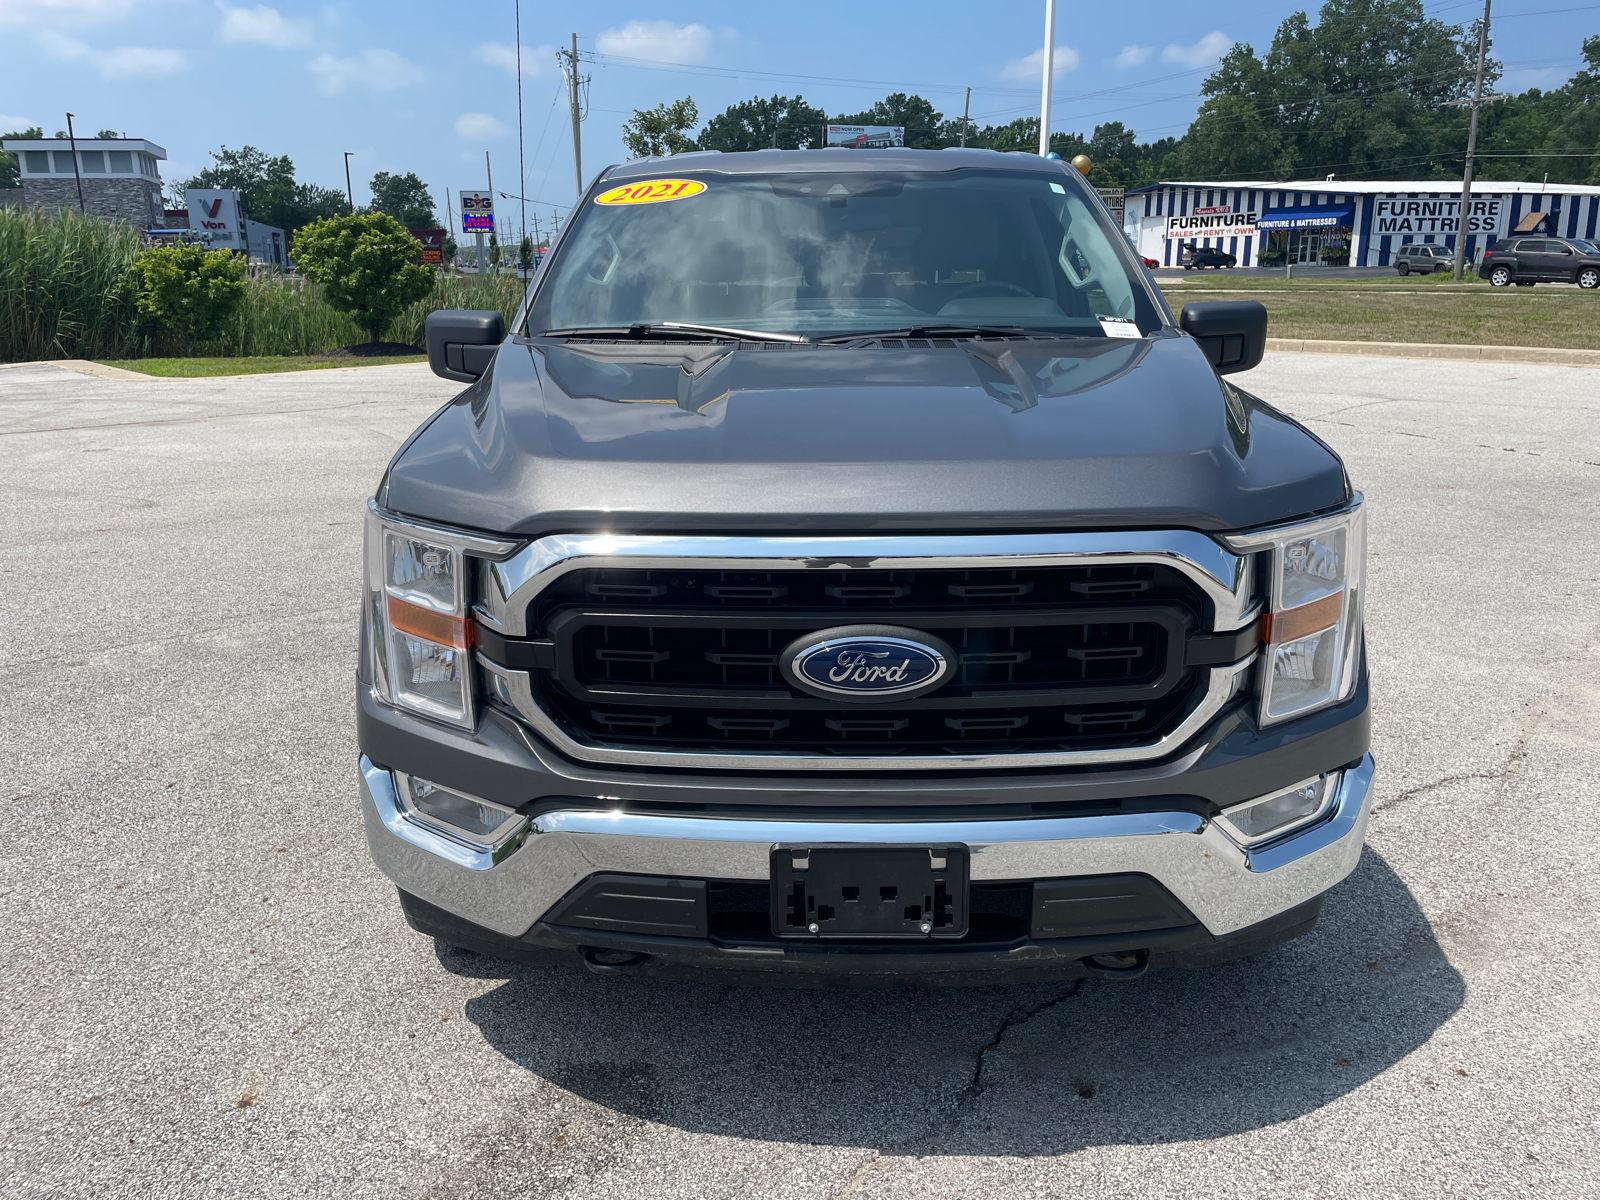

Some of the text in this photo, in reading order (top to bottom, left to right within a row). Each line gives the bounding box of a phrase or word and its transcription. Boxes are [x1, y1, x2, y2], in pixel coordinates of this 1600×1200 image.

[609, 183, 690, 202] 2021
[1102, 197, 1124, 207] NITURE
[1377, 202, 1500, 216] FURNITURE
[201, 220, 226, 229] Von
[1170, 214, 1256, 229] FURNITURE
[1258, 220, 1289, 229] FURNITURE
[1296, 218, 1336, 226] MATTRESSES
[1378, 217, 1495, 232] MATTRSS
[212, 232, 232, 240] bel
[829, 650, 910, 682] Ford
